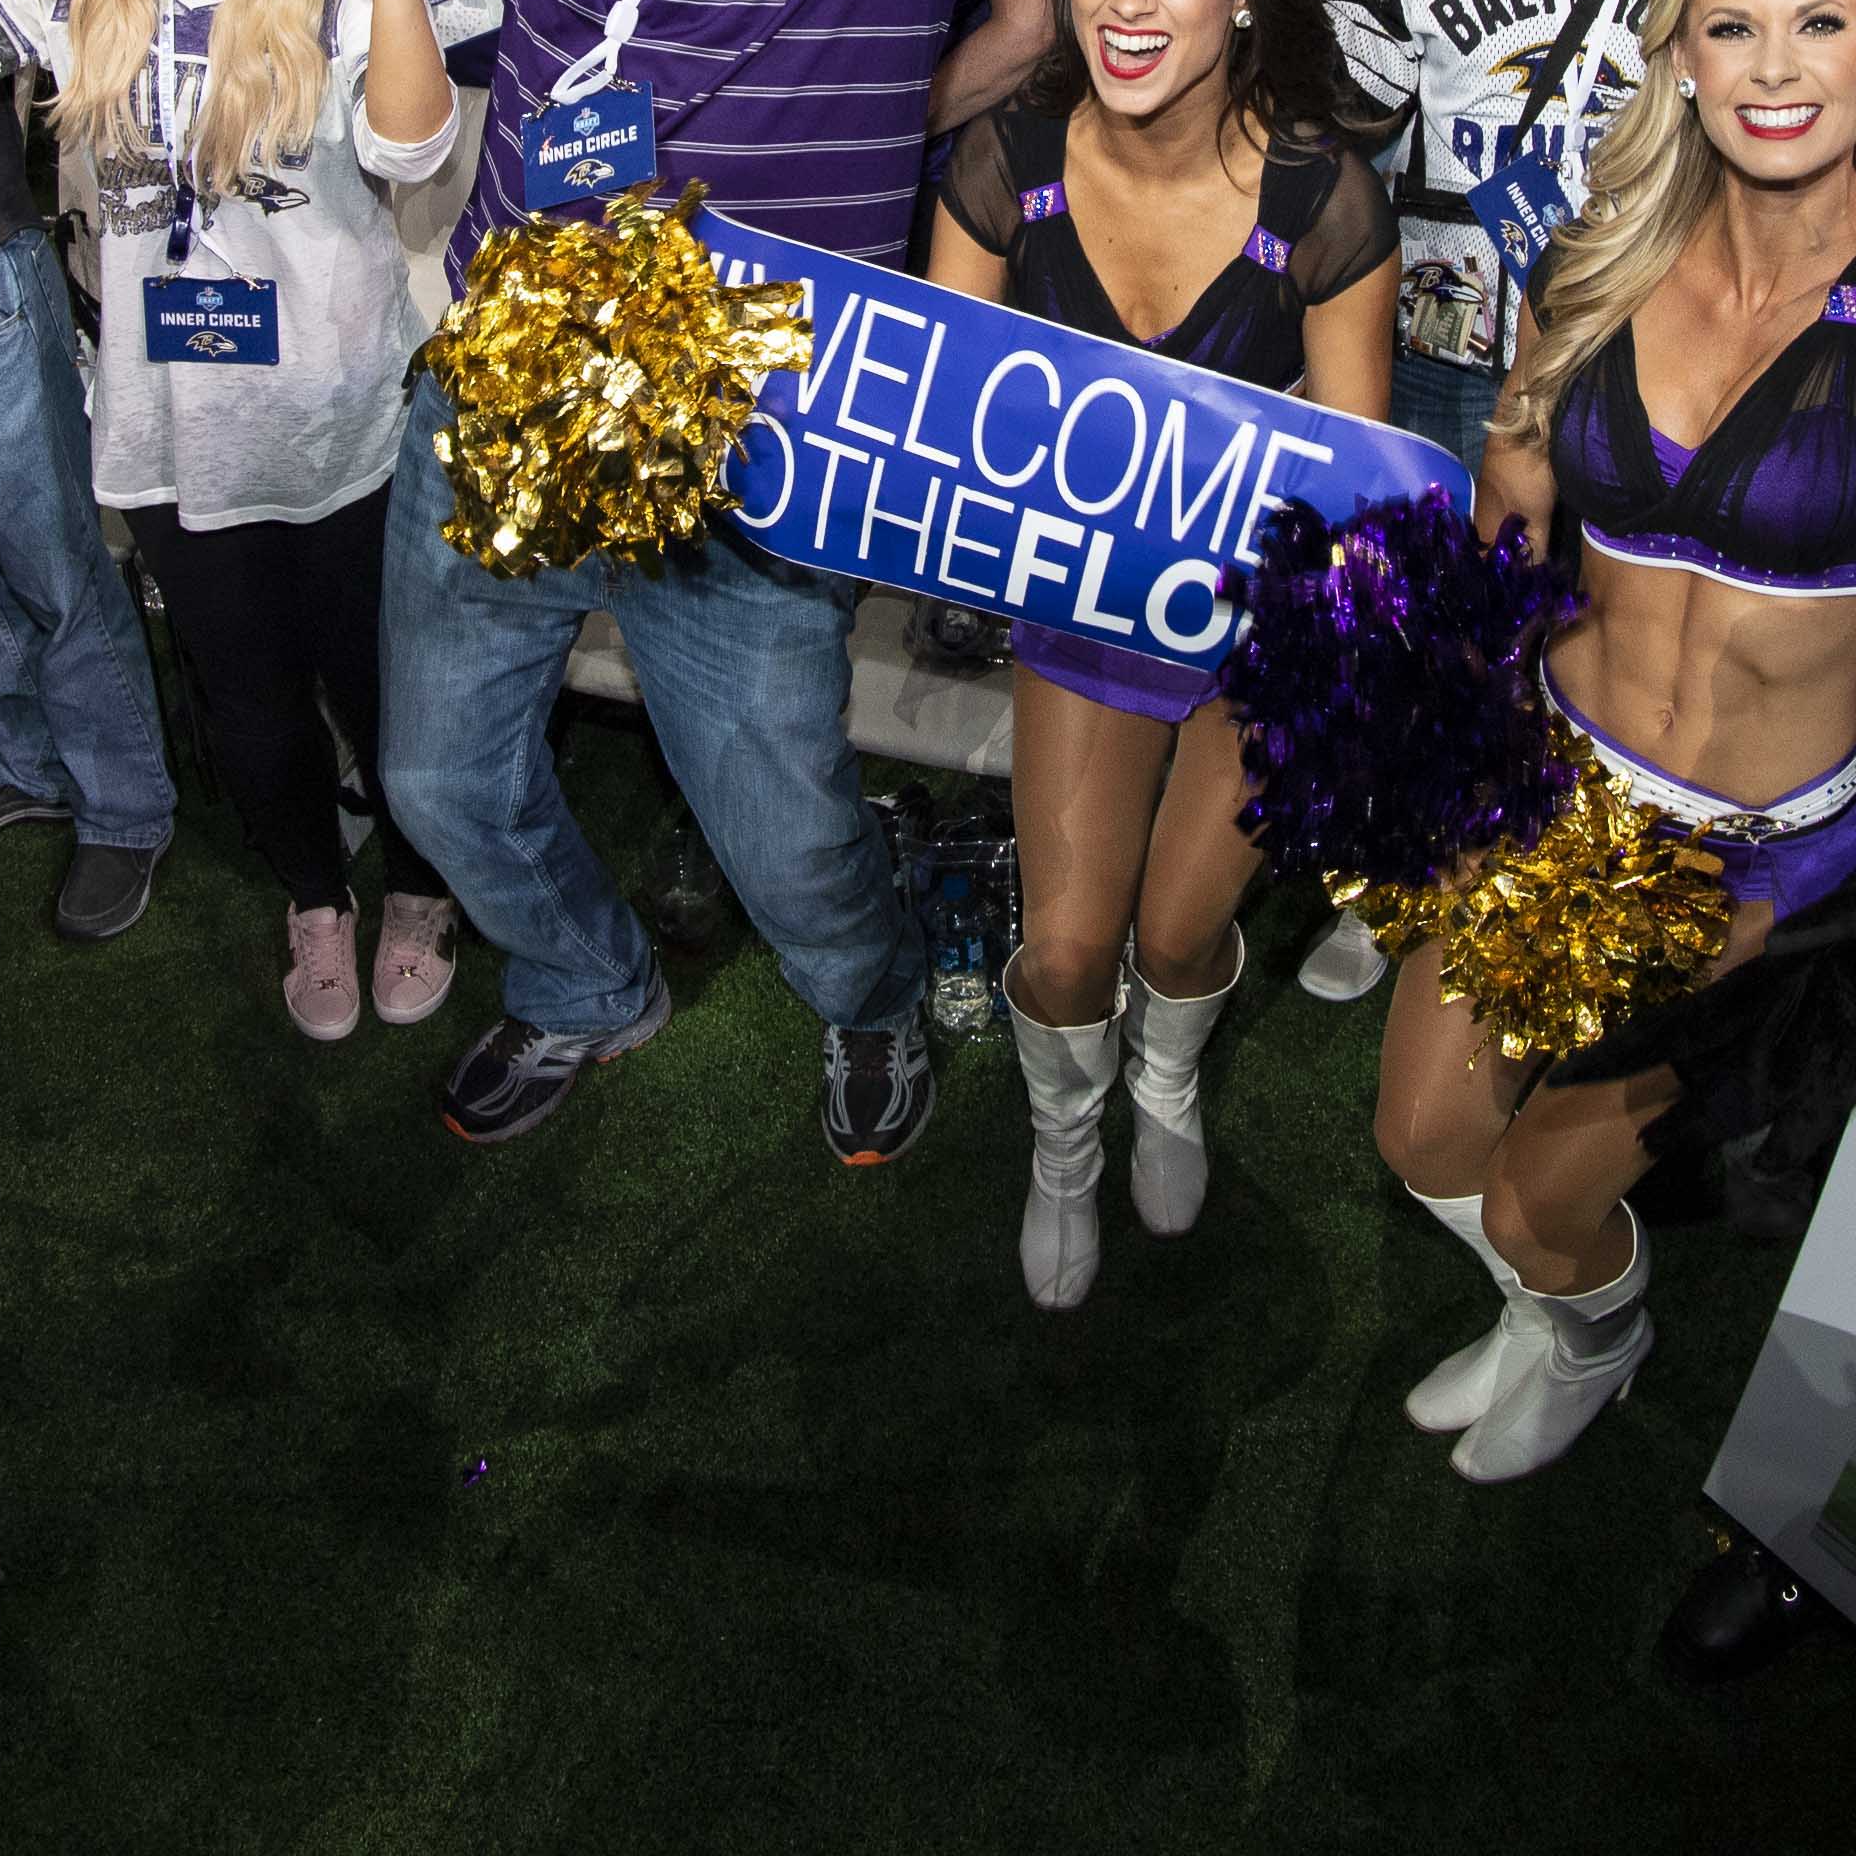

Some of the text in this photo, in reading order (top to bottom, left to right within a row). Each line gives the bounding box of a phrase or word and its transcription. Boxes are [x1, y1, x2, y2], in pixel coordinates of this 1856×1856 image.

[539, 125, 639, 166] INNER CIRCLE
[1506, 181, 1539, 228] INNER
[160, 312, 261, 328] INNER CIRCLE
[714, 256, 1334, 568] WELCOME
